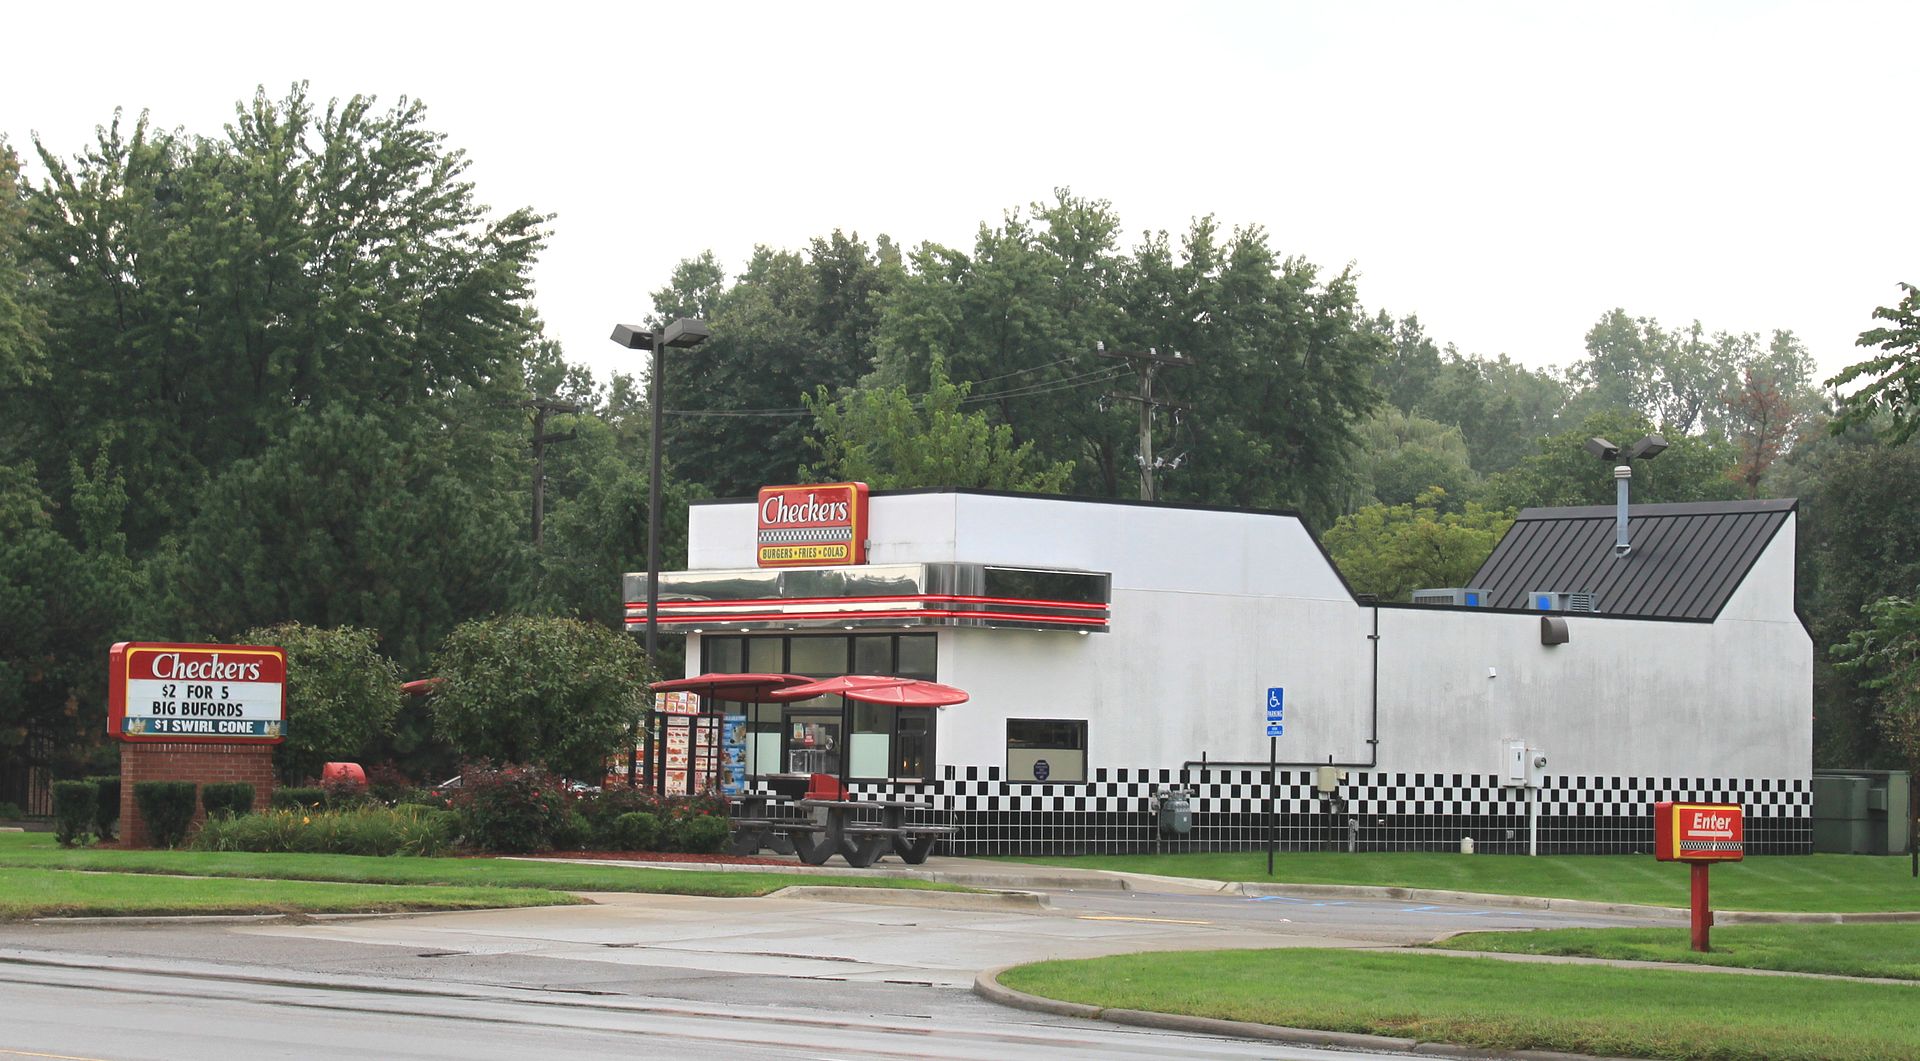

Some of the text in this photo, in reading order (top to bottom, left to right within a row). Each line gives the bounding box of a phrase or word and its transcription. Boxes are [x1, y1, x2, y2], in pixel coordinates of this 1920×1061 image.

[761, 494, 848, 524] Checkers
[762, 546, 844, 559] BURGERS FRIES COLAS
[152, 653, 260, 680] Checkers
[162, 684, 229, 699] $2 FOR 5
[152, 701, 243, 717] BIG BUFORDS
[154, 720, 254, 734] $1 SWIRL CONE
[1693, 813, 1732, 830] Enter
